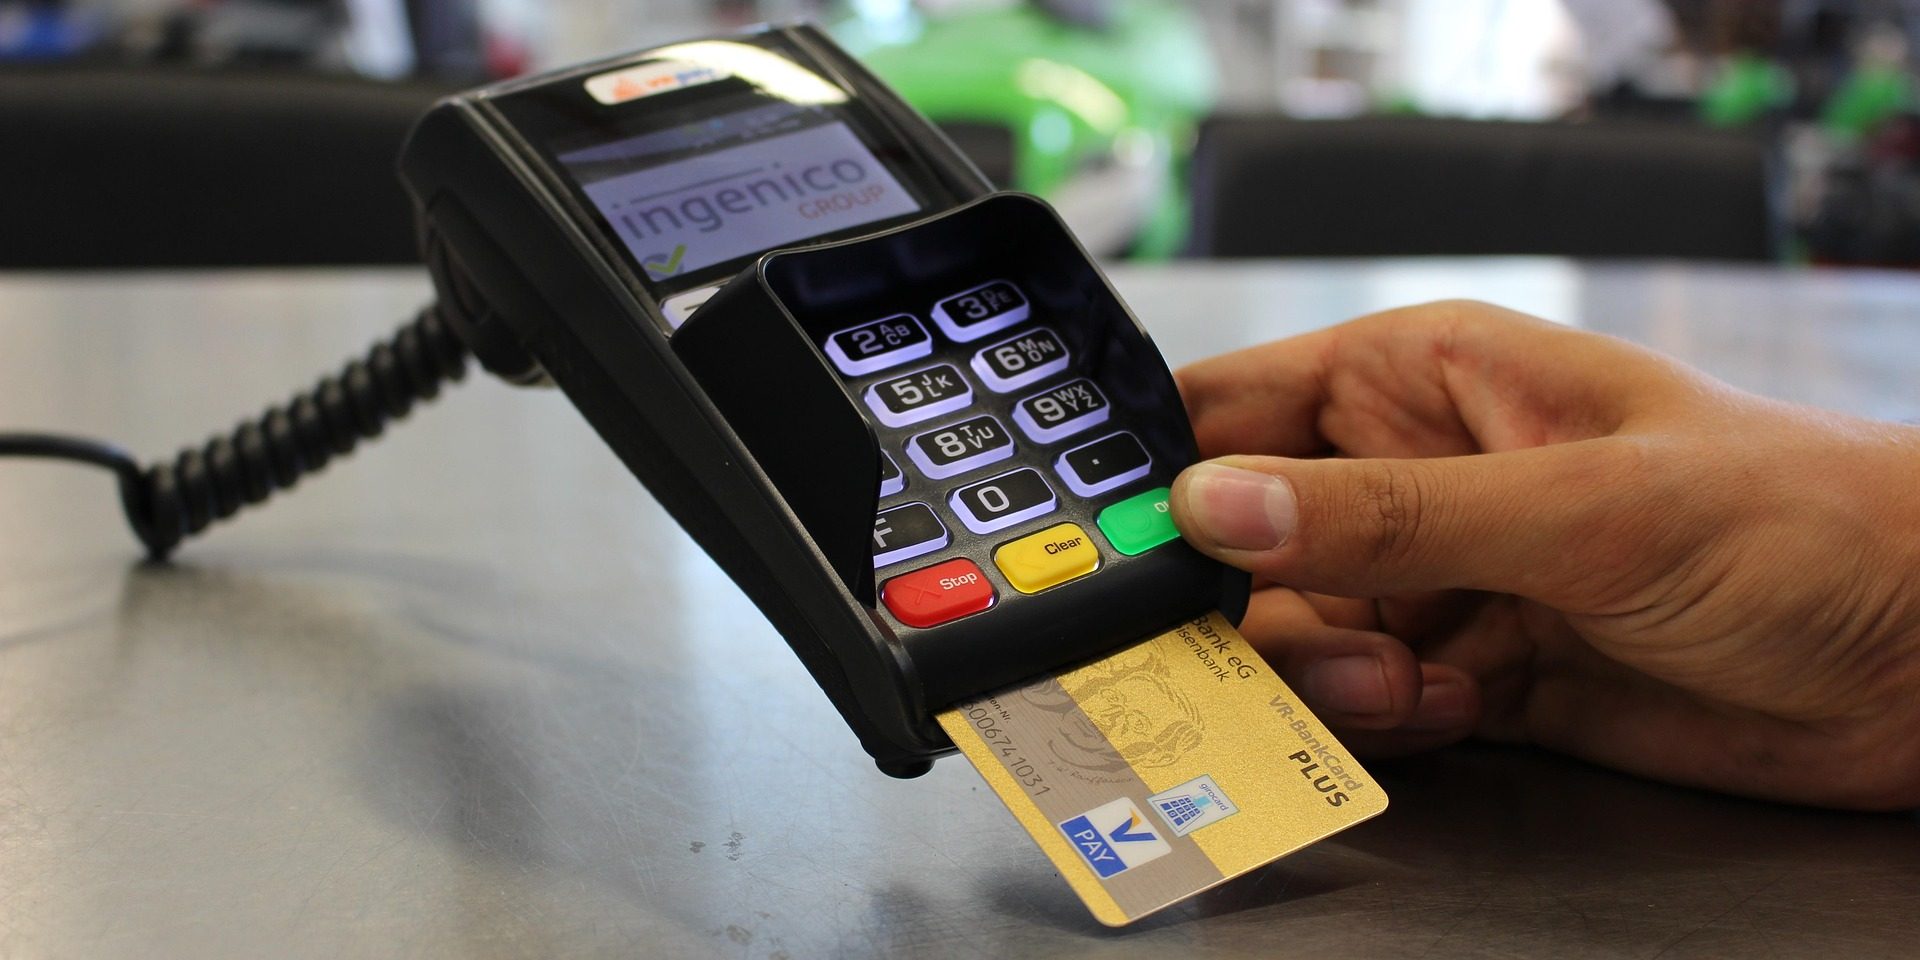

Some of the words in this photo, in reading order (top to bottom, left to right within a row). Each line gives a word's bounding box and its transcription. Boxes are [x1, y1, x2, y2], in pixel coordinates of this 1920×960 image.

[611, 158, 867, 240] ingenico
[799, 183, 886, 221] GROUP
[958, 296, 989, 319] 3
[851, 329, 884, 355] 2
[995, 346, 1026, 371] 6
[890, 379, 924, 405] 5
[1033, 397, 1066, 422] 9
[933, 431, 967, 457] 8
[976, 486, 1010, 513] 0
[1044, 534, 1083, 556] Clear
[939, 571, 978, 591] Stop
[1192, 615, 1232, 655] Bank
[1227, 656, 1257, 679] eG
[1268, 694, 1364, 791] VR-BankCard
[1288, 750, 1350, 808] PLUS
[1199, 783, 1229, 811] girocard
[1074, 829, 1115, 862] PAY
